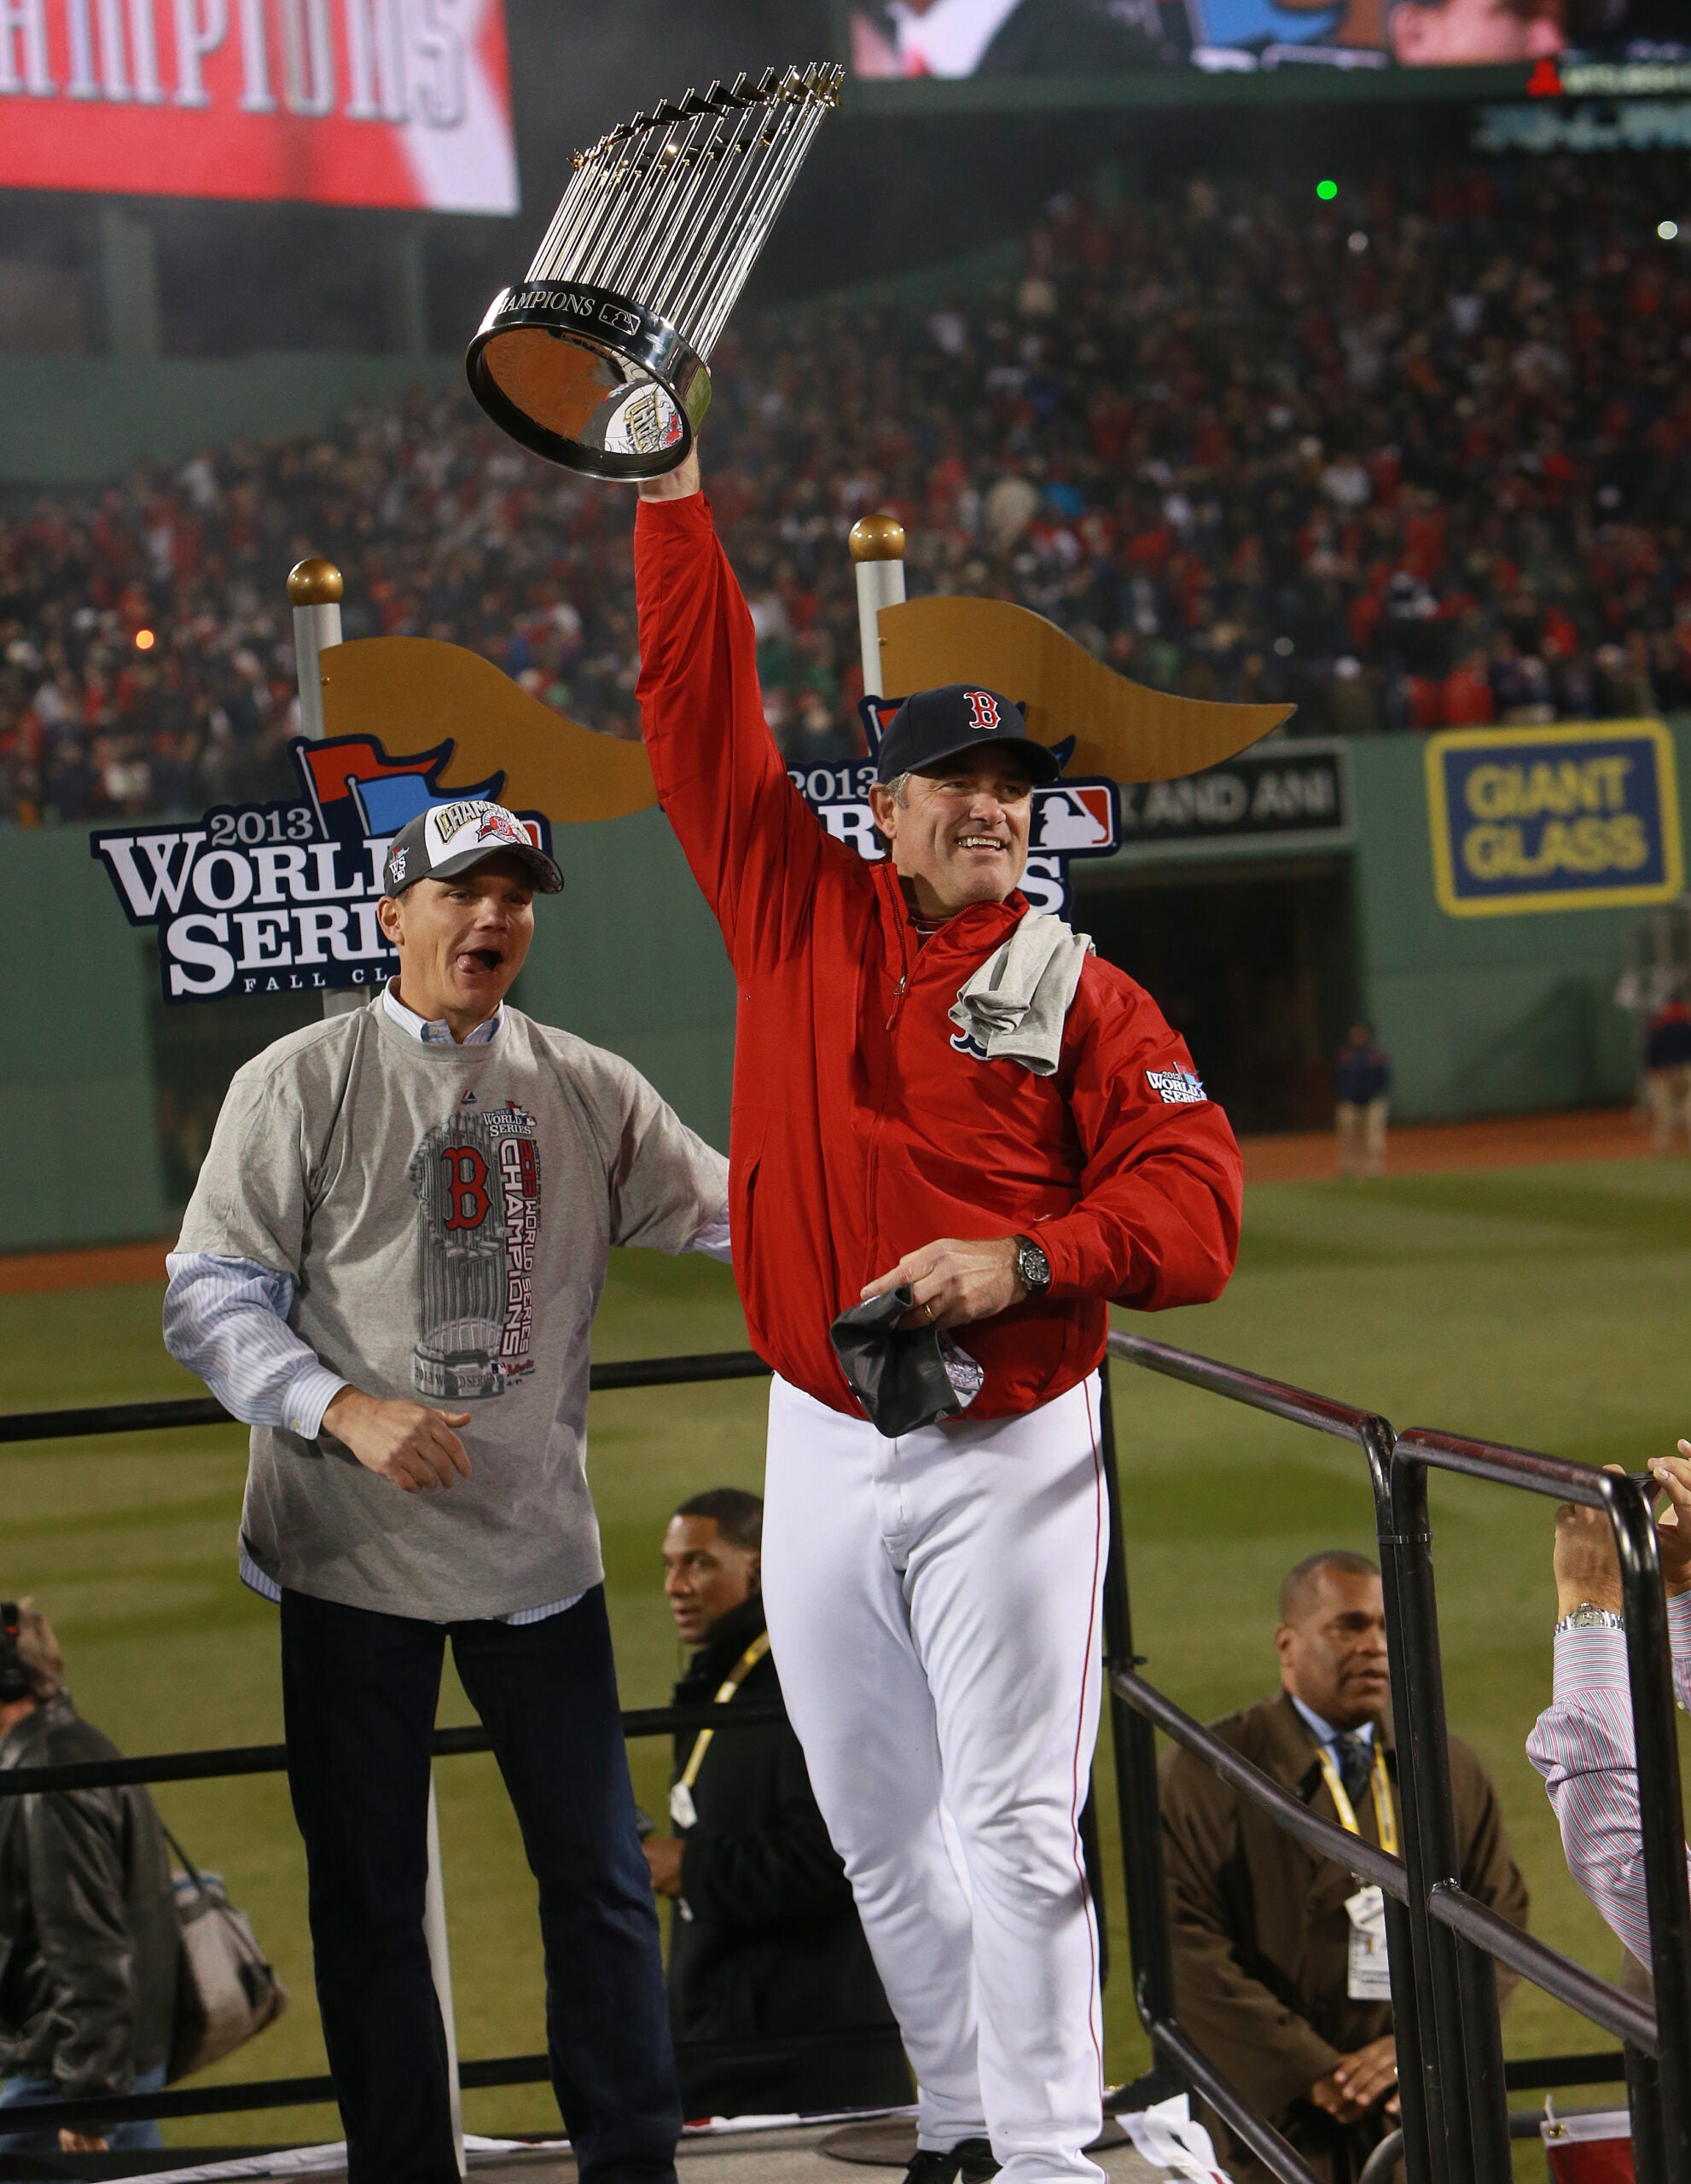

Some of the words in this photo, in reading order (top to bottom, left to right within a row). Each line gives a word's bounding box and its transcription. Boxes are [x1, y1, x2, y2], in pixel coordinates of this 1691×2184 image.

[963, 691, 1002, 729] B
[1464, 757, 1630, 820] GIANT
[211, 807, 314, 847] 2013
[1462, 814, 1648, 881] GLASS
[388, 856, 406, 874] WS
[166, 902, 399, 996] SERI
[244, 973, 326, 993] FALL
[1145, 1070, 1198, 1097] WORLD
[482, 1112, 522, 1125] WORLD
[490, 1124, 532, 1137] SERIES
[442, 1146, 491, 1230] B
[519, 1139, 537, 1197] 2013
[500, 1139, 524, 1356] CHAMPIONS
[523, 1200, 537, 1271] WORLD
[520, 1275, 532, 1354] SERIES
